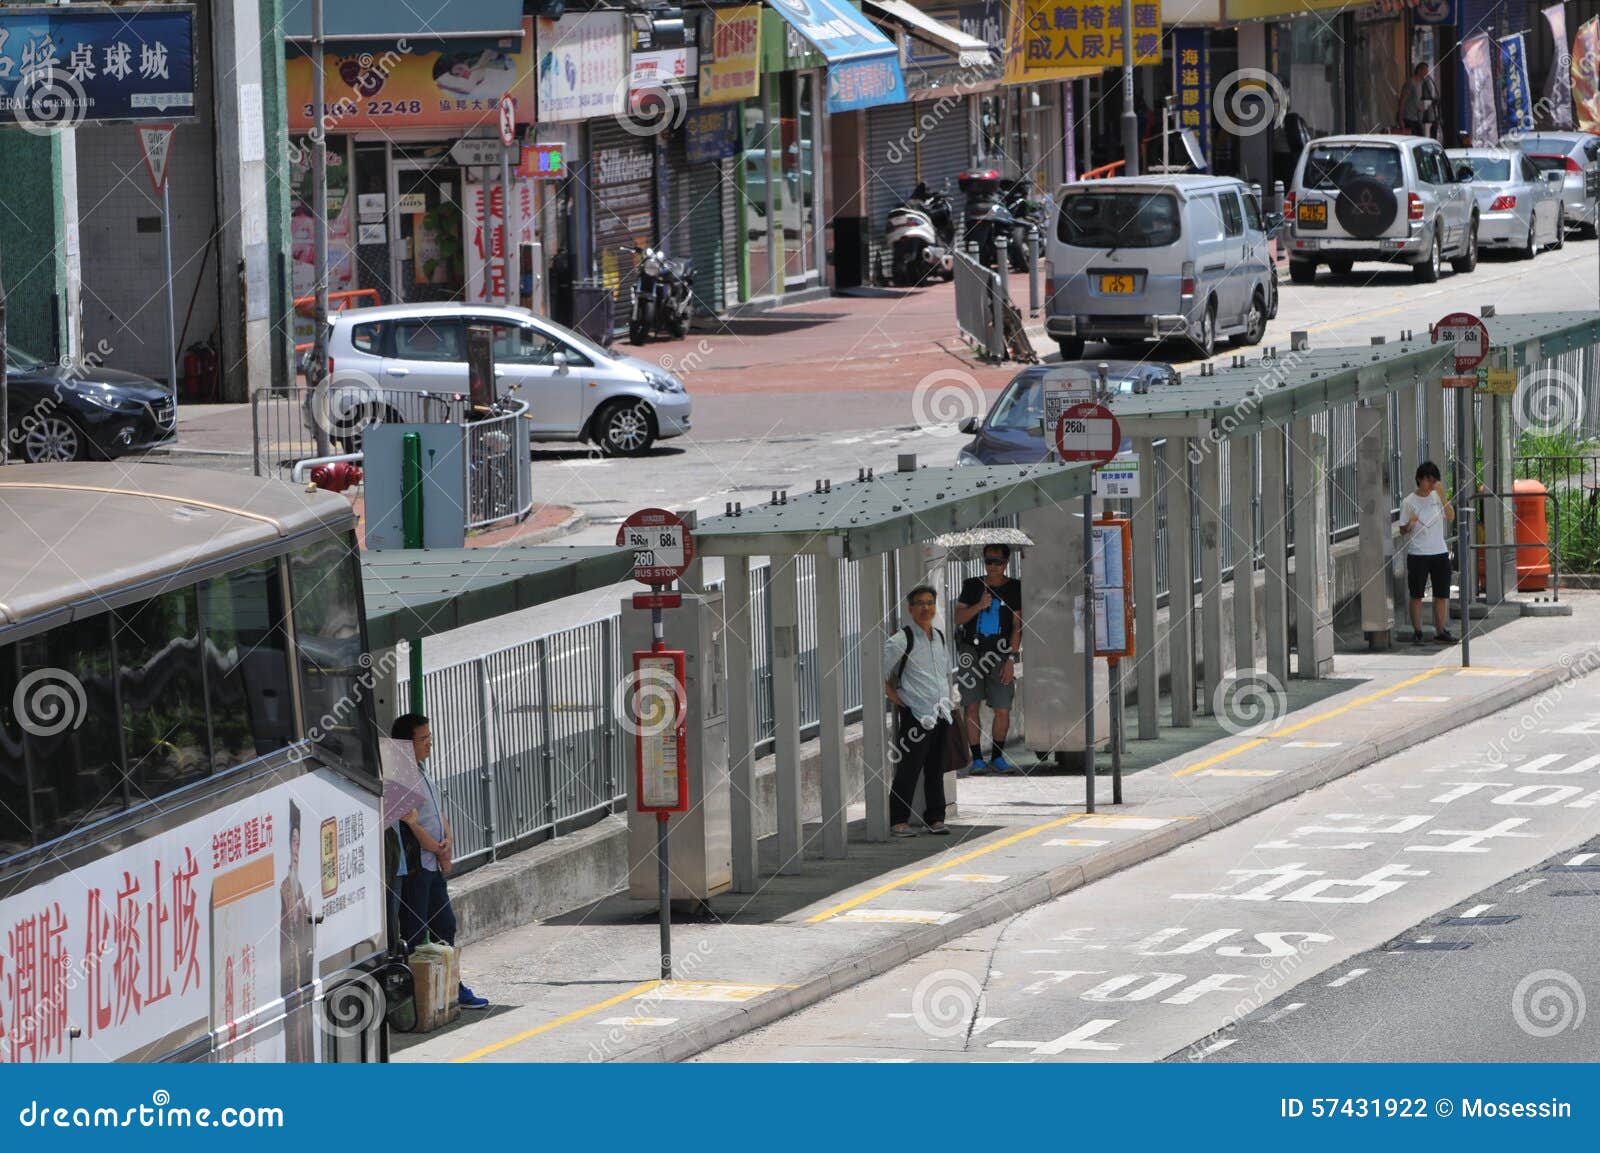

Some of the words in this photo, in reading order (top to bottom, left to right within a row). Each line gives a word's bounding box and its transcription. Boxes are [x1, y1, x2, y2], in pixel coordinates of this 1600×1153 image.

[1182, 49, 1199, 130] 海溢膠輪
[367, 100, 422, 116] 2248
[659, 533, 677, 547] 68A
[633, 550, 654, 566] 260
[634, 568, 652, 577] BUS
[655, 567, 679, 577] STOP
[85, 846, 201, 1041] 化痰止咳
